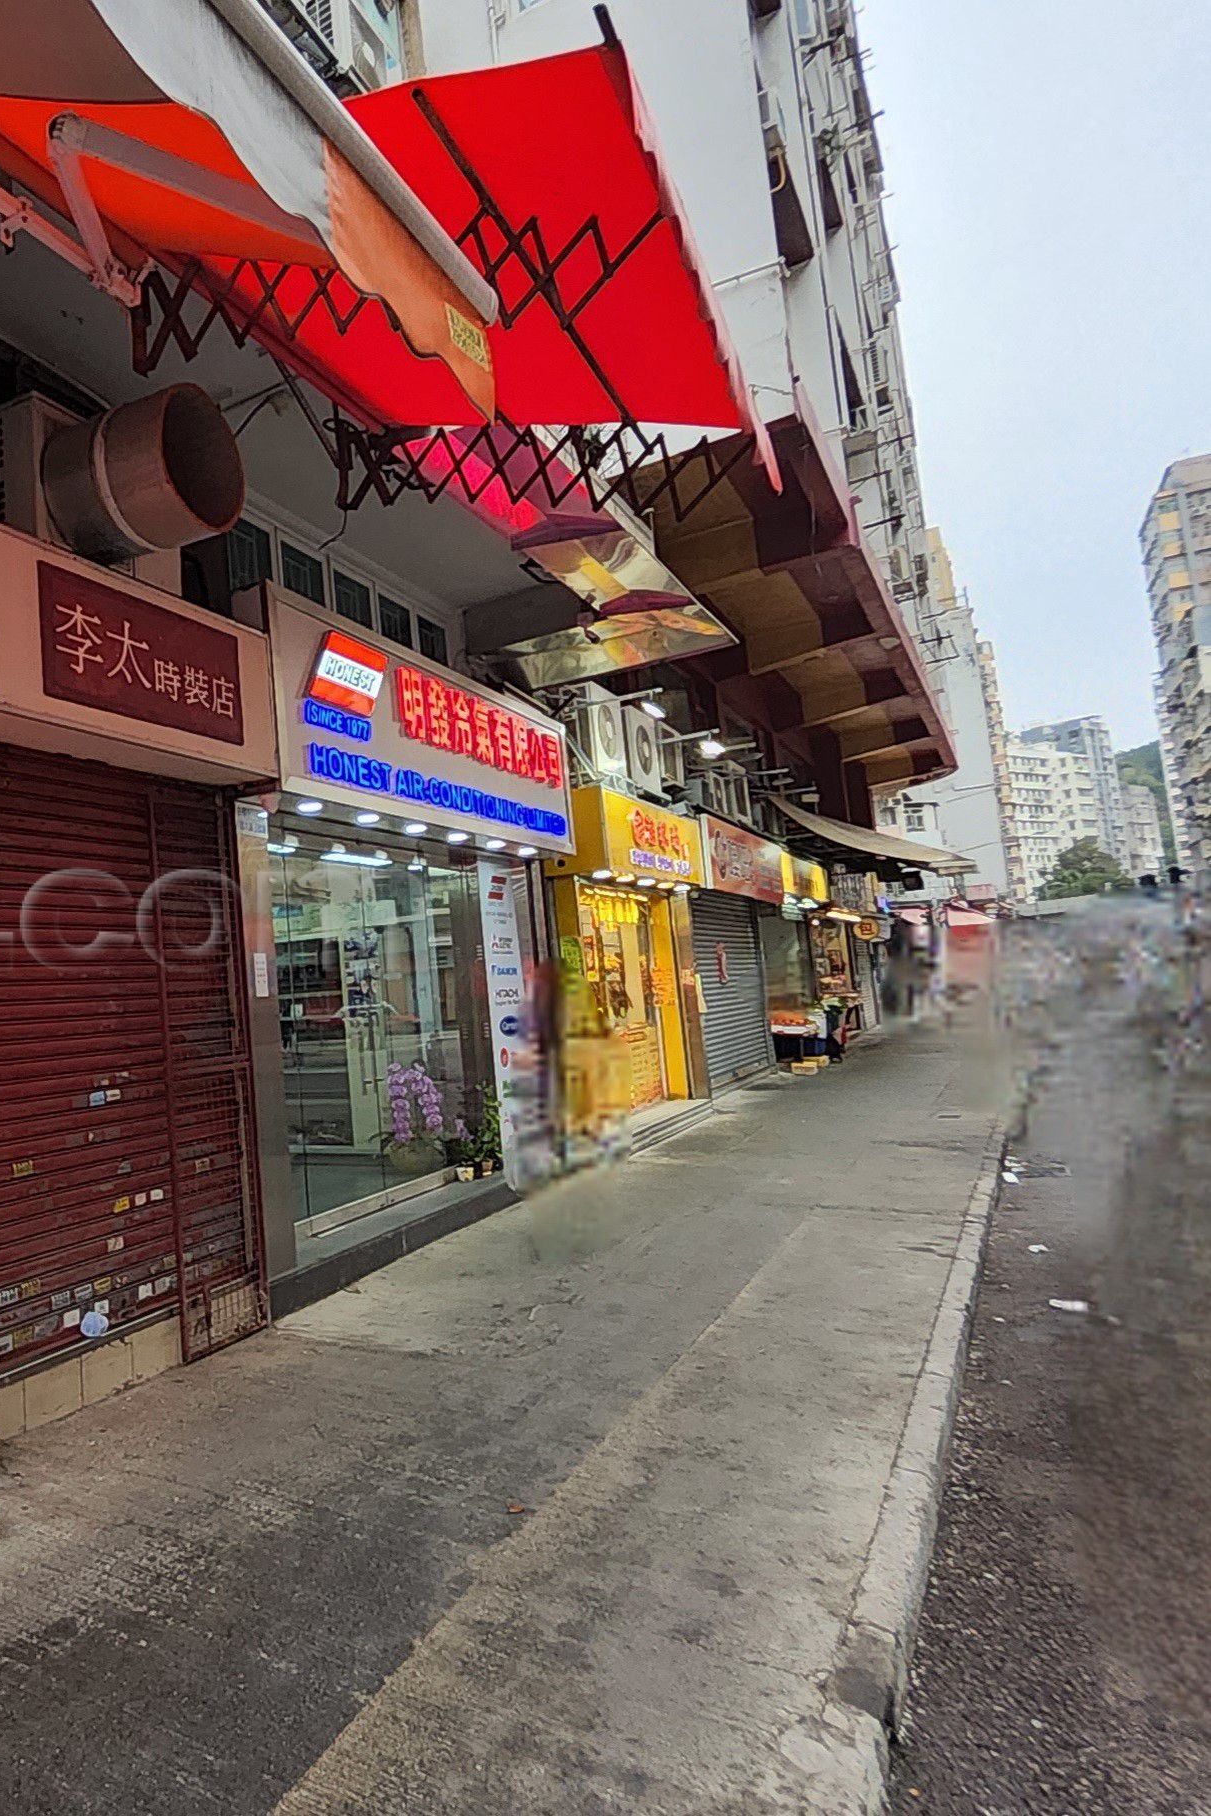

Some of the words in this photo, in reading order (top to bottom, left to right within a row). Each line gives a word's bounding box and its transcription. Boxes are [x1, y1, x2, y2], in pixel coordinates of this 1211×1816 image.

[55, 603, 235, 719] 李太時裝店
[325, 656, 377, 692] HONEST
[395, 666, 564, 789] 明發冷氣有限公司
[309, 742, 393, 792] HONEST
[394, 768, 525, 826] AIR-CONDITIONING
